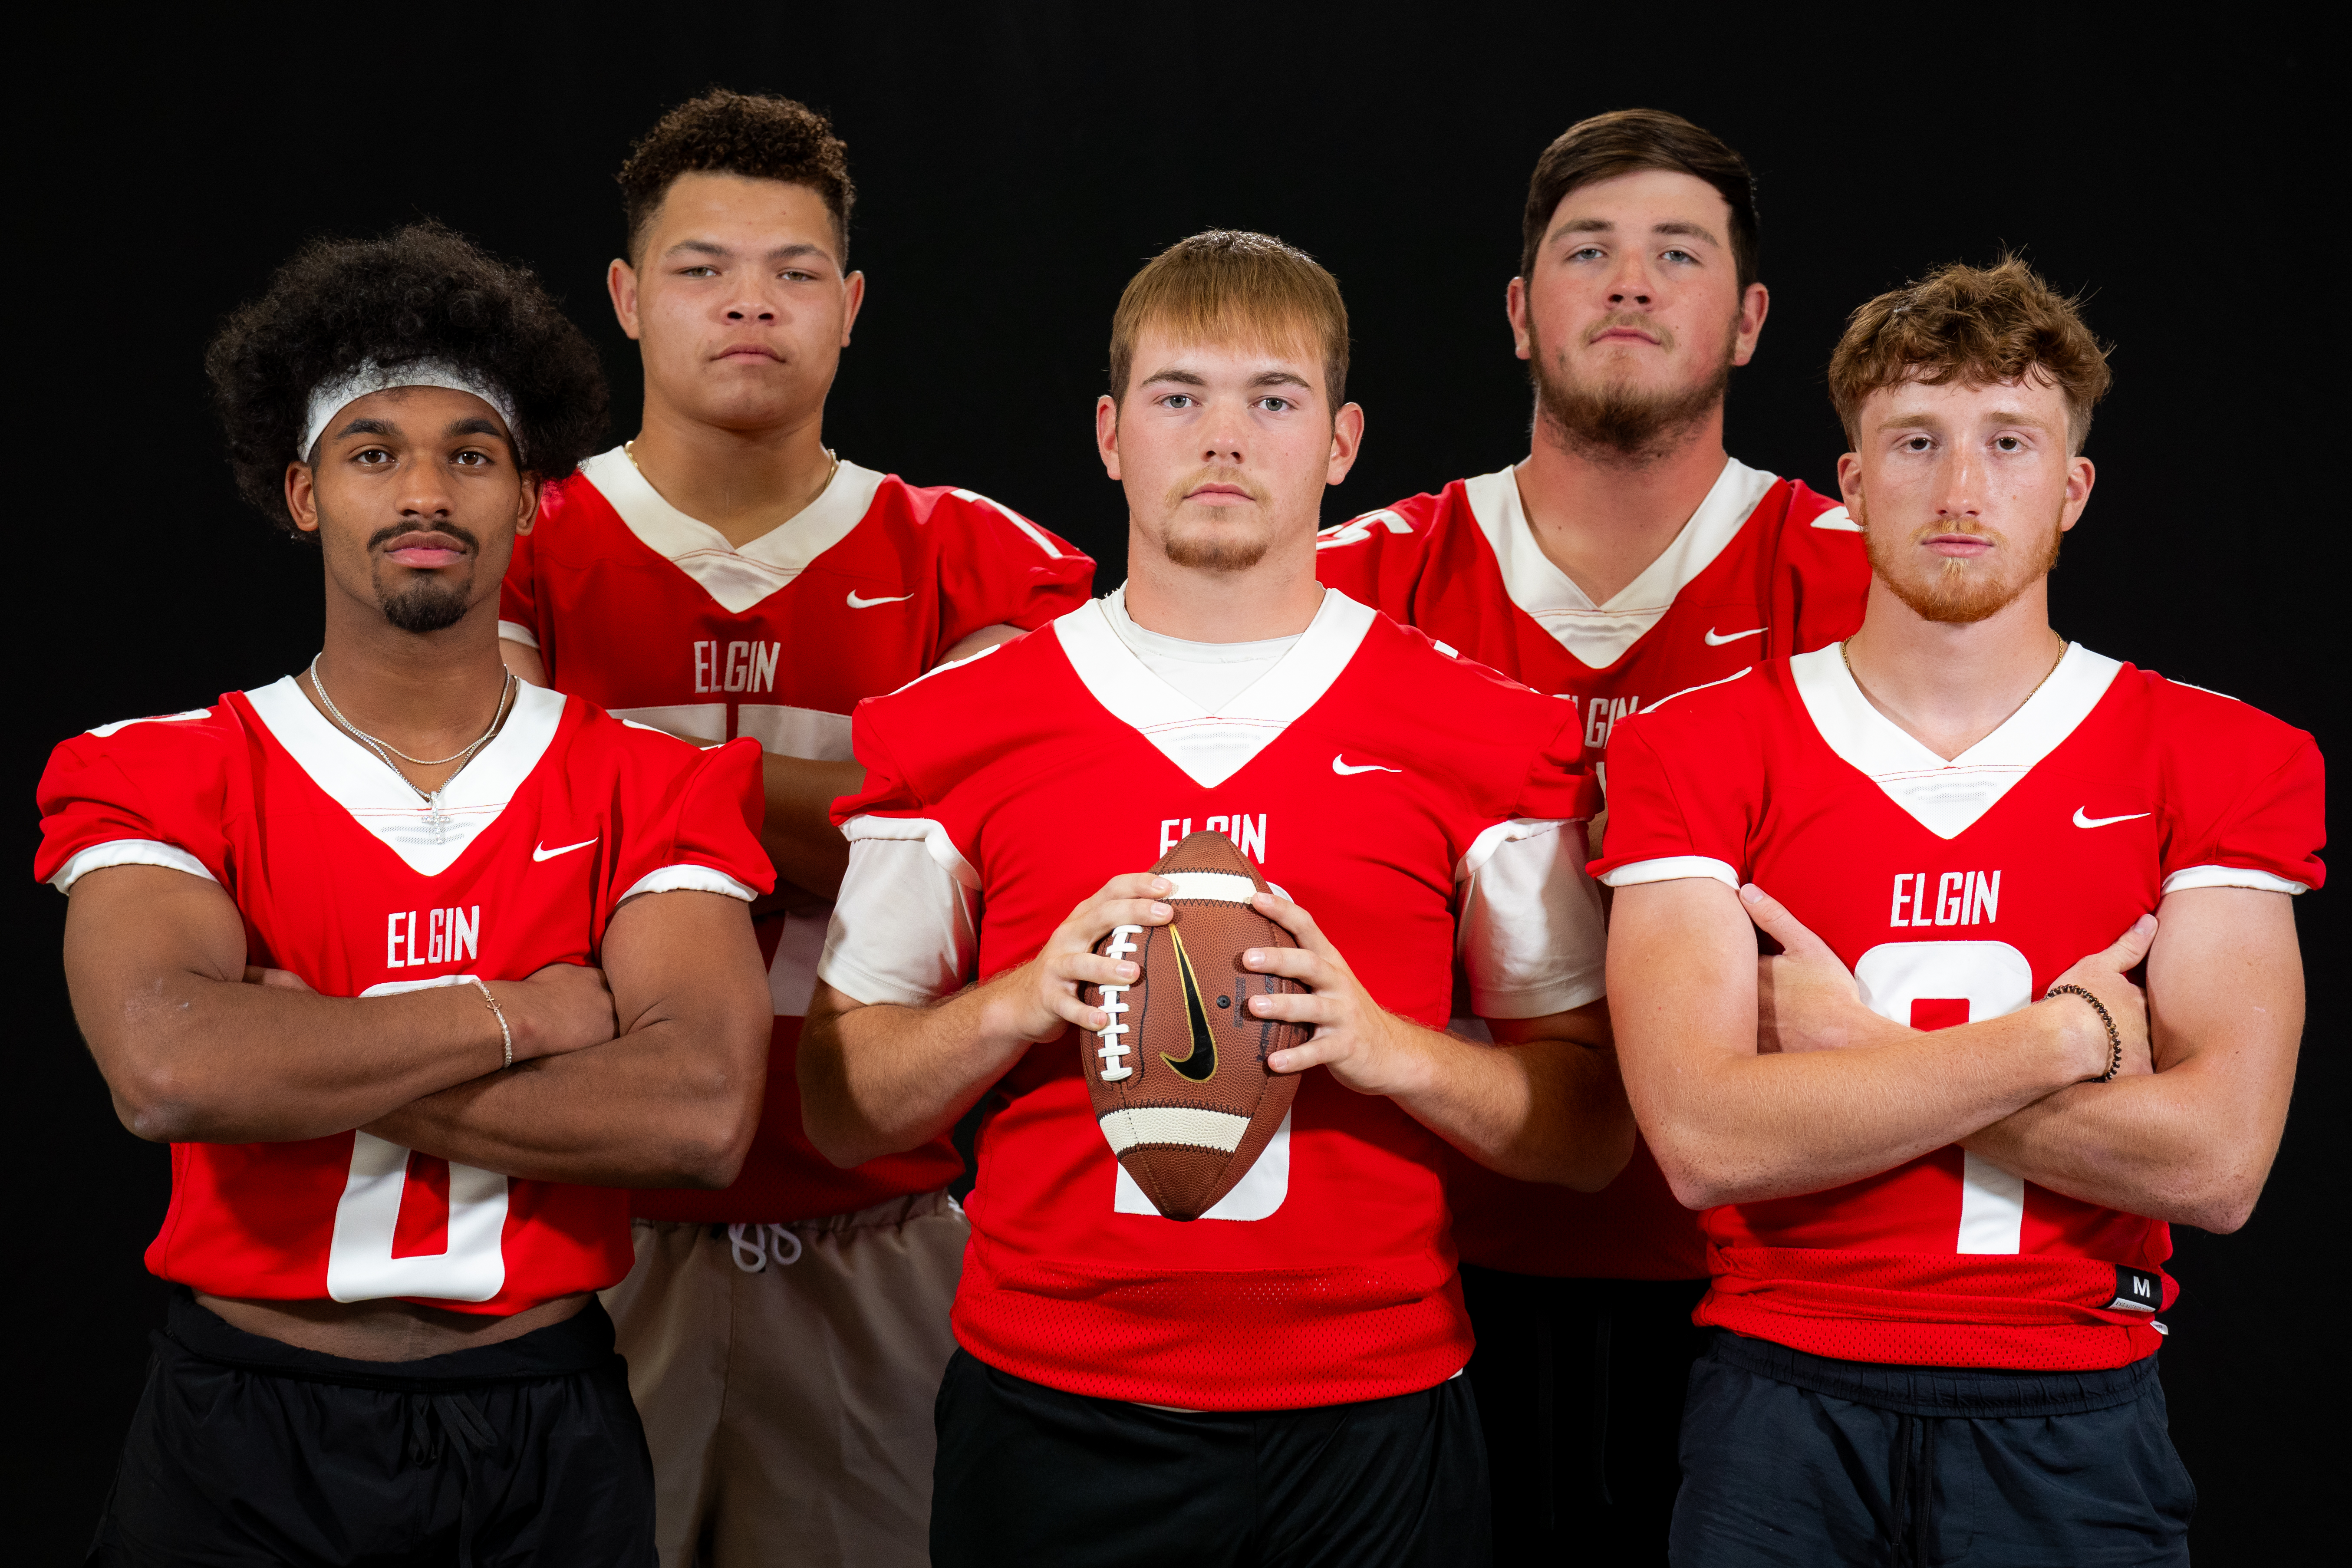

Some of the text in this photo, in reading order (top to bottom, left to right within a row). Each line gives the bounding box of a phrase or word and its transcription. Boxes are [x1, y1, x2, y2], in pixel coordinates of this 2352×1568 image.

[694, 640, 781, 693] ELGIN
[1890, 870, 2002, 927] ELGIN
[387, 905, 480, 968] ELGIN
[2133, 1275, 2150, 1298] M
